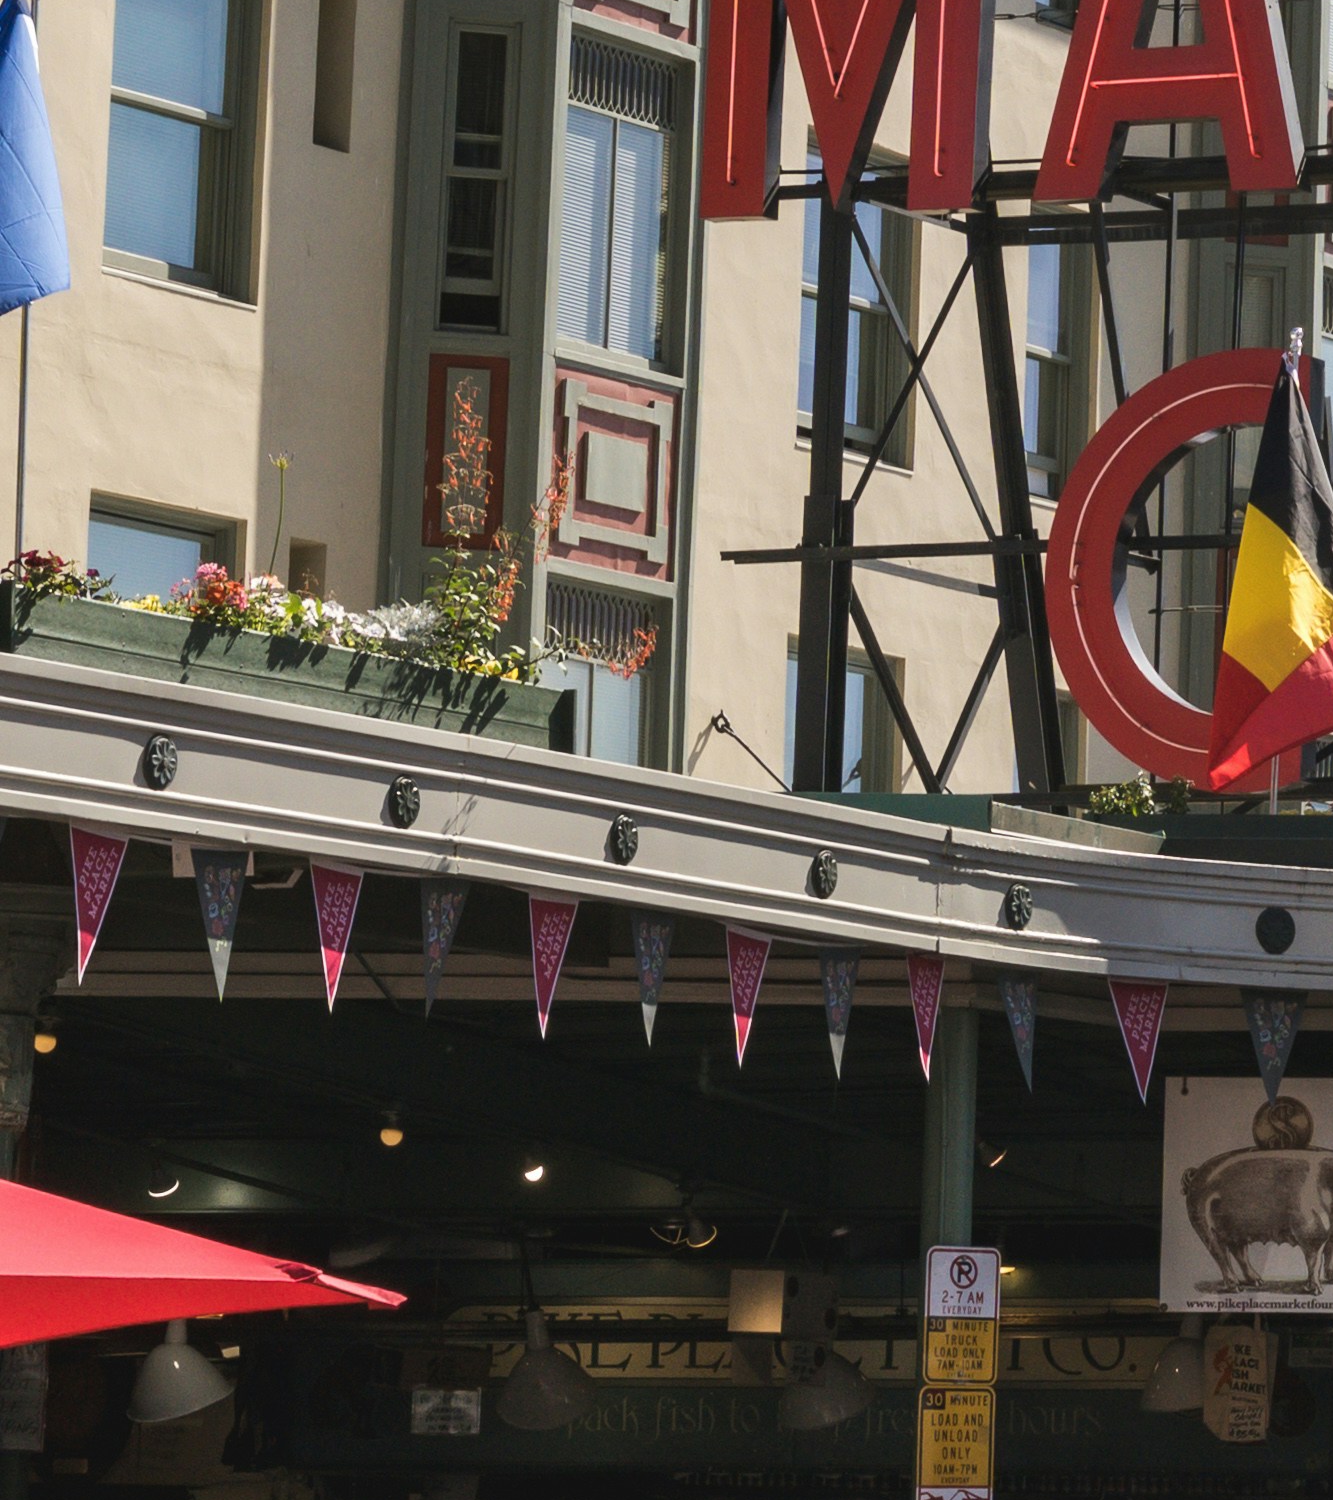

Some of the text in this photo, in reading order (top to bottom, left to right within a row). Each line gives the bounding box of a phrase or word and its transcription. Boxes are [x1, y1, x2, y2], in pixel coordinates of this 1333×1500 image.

[942, 1290, 984, 1304] 2-7 AM
[942, 1306, 982, 1315] EVERYDAY
[930, 1320, 988, 1332] 30 MINUTE
[946, 1335, 978, 1345] TRUCK
[934, 1348, 986, 1358] LOAD ONLY
[926, 1393, 988, 1406] 30 MINUTE
[931, 1413, 983, 1426] LOAD AND
[934, 1430, 978, 1442] UNLOAD
[942, 1447, 971, 1459] ONLY
[934, 1464, 977, 1474] 10AM-7PM
